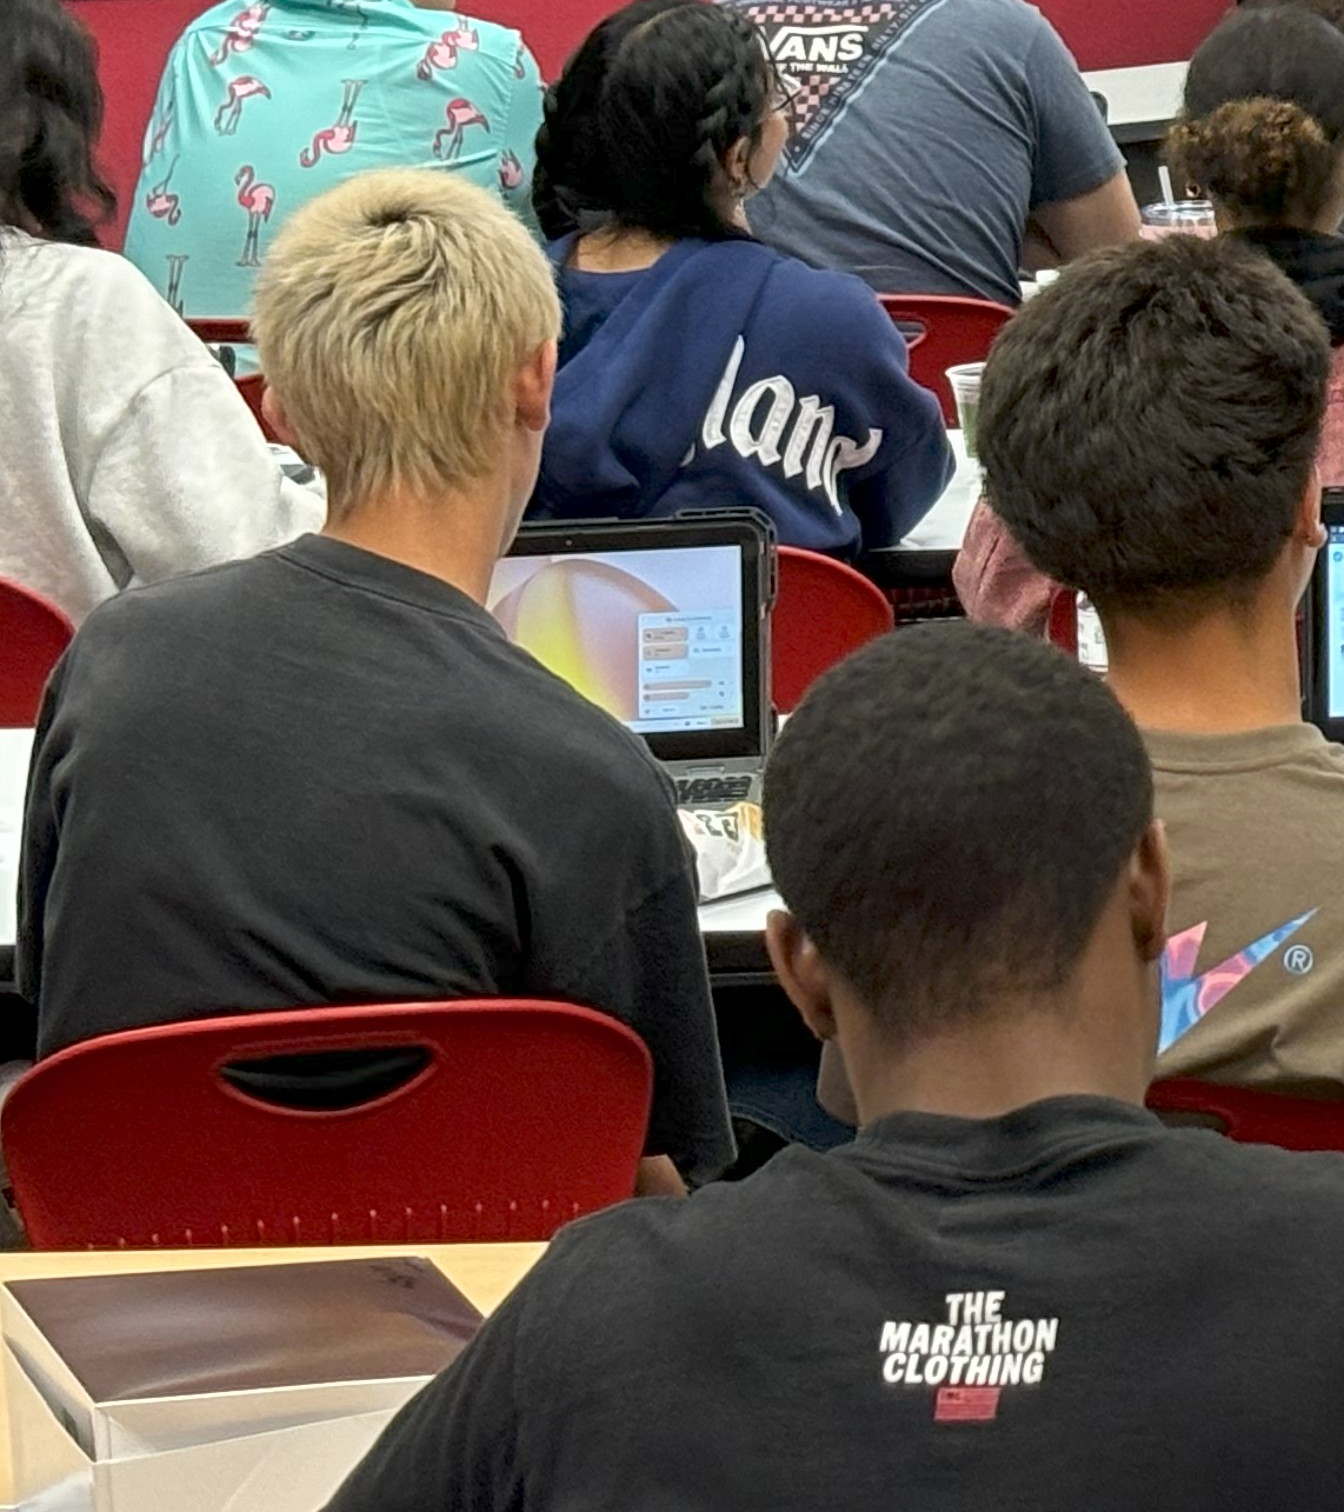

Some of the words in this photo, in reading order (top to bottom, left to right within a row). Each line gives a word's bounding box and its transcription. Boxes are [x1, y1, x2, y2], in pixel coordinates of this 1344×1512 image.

[756, 24, 869, 62] VANS
[790, 62, 813, 74] THE
[816, 62, 849, 74] WALL
[945, 1291, 1006, 1326] THE
[879, 1318, 1059, 1356] MARATHON
[882, 1351, 1046, 1386] CLOTHING
